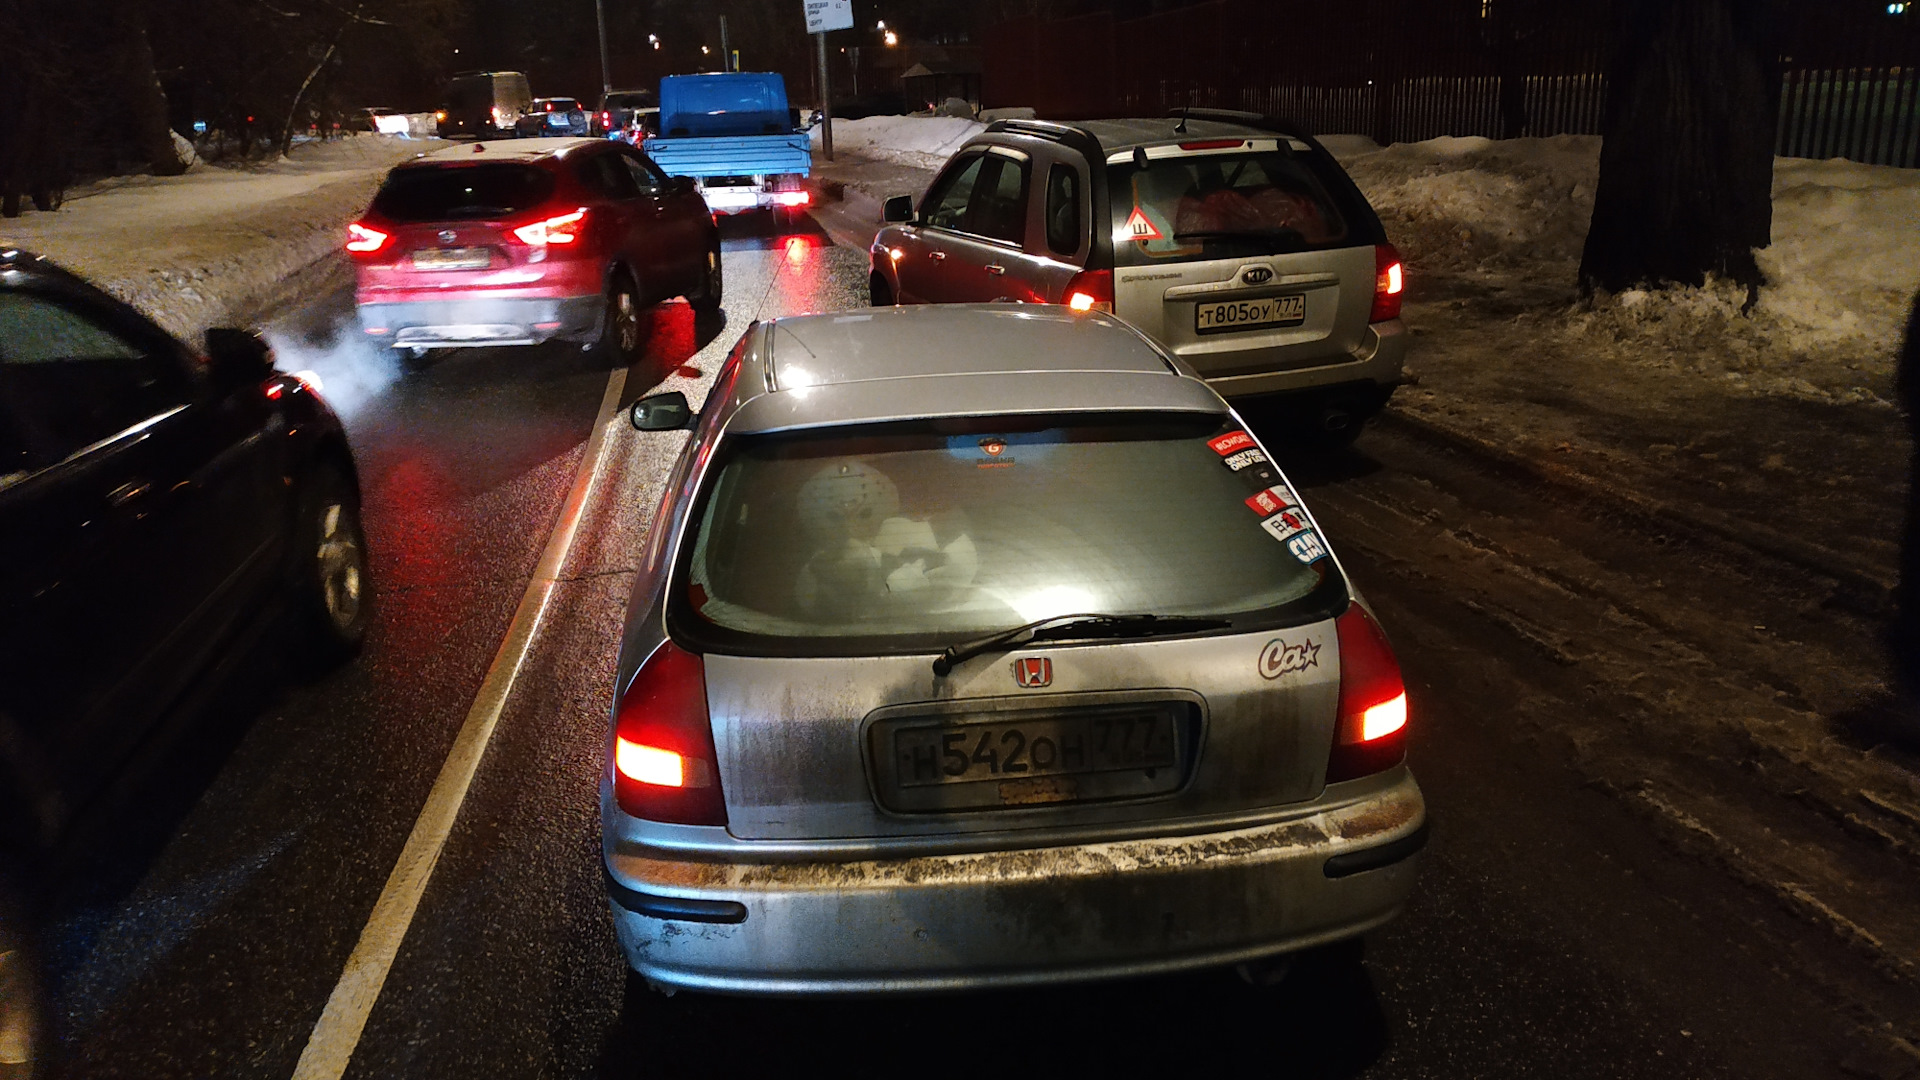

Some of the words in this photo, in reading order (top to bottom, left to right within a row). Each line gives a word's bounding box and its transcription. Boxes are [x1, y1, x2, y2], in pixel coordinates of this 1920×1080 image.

[1133, 223, 1148, 235] Ш
[1247, 270, 1268, 281] KIA
[1275, 297, 1300, 313] 777
